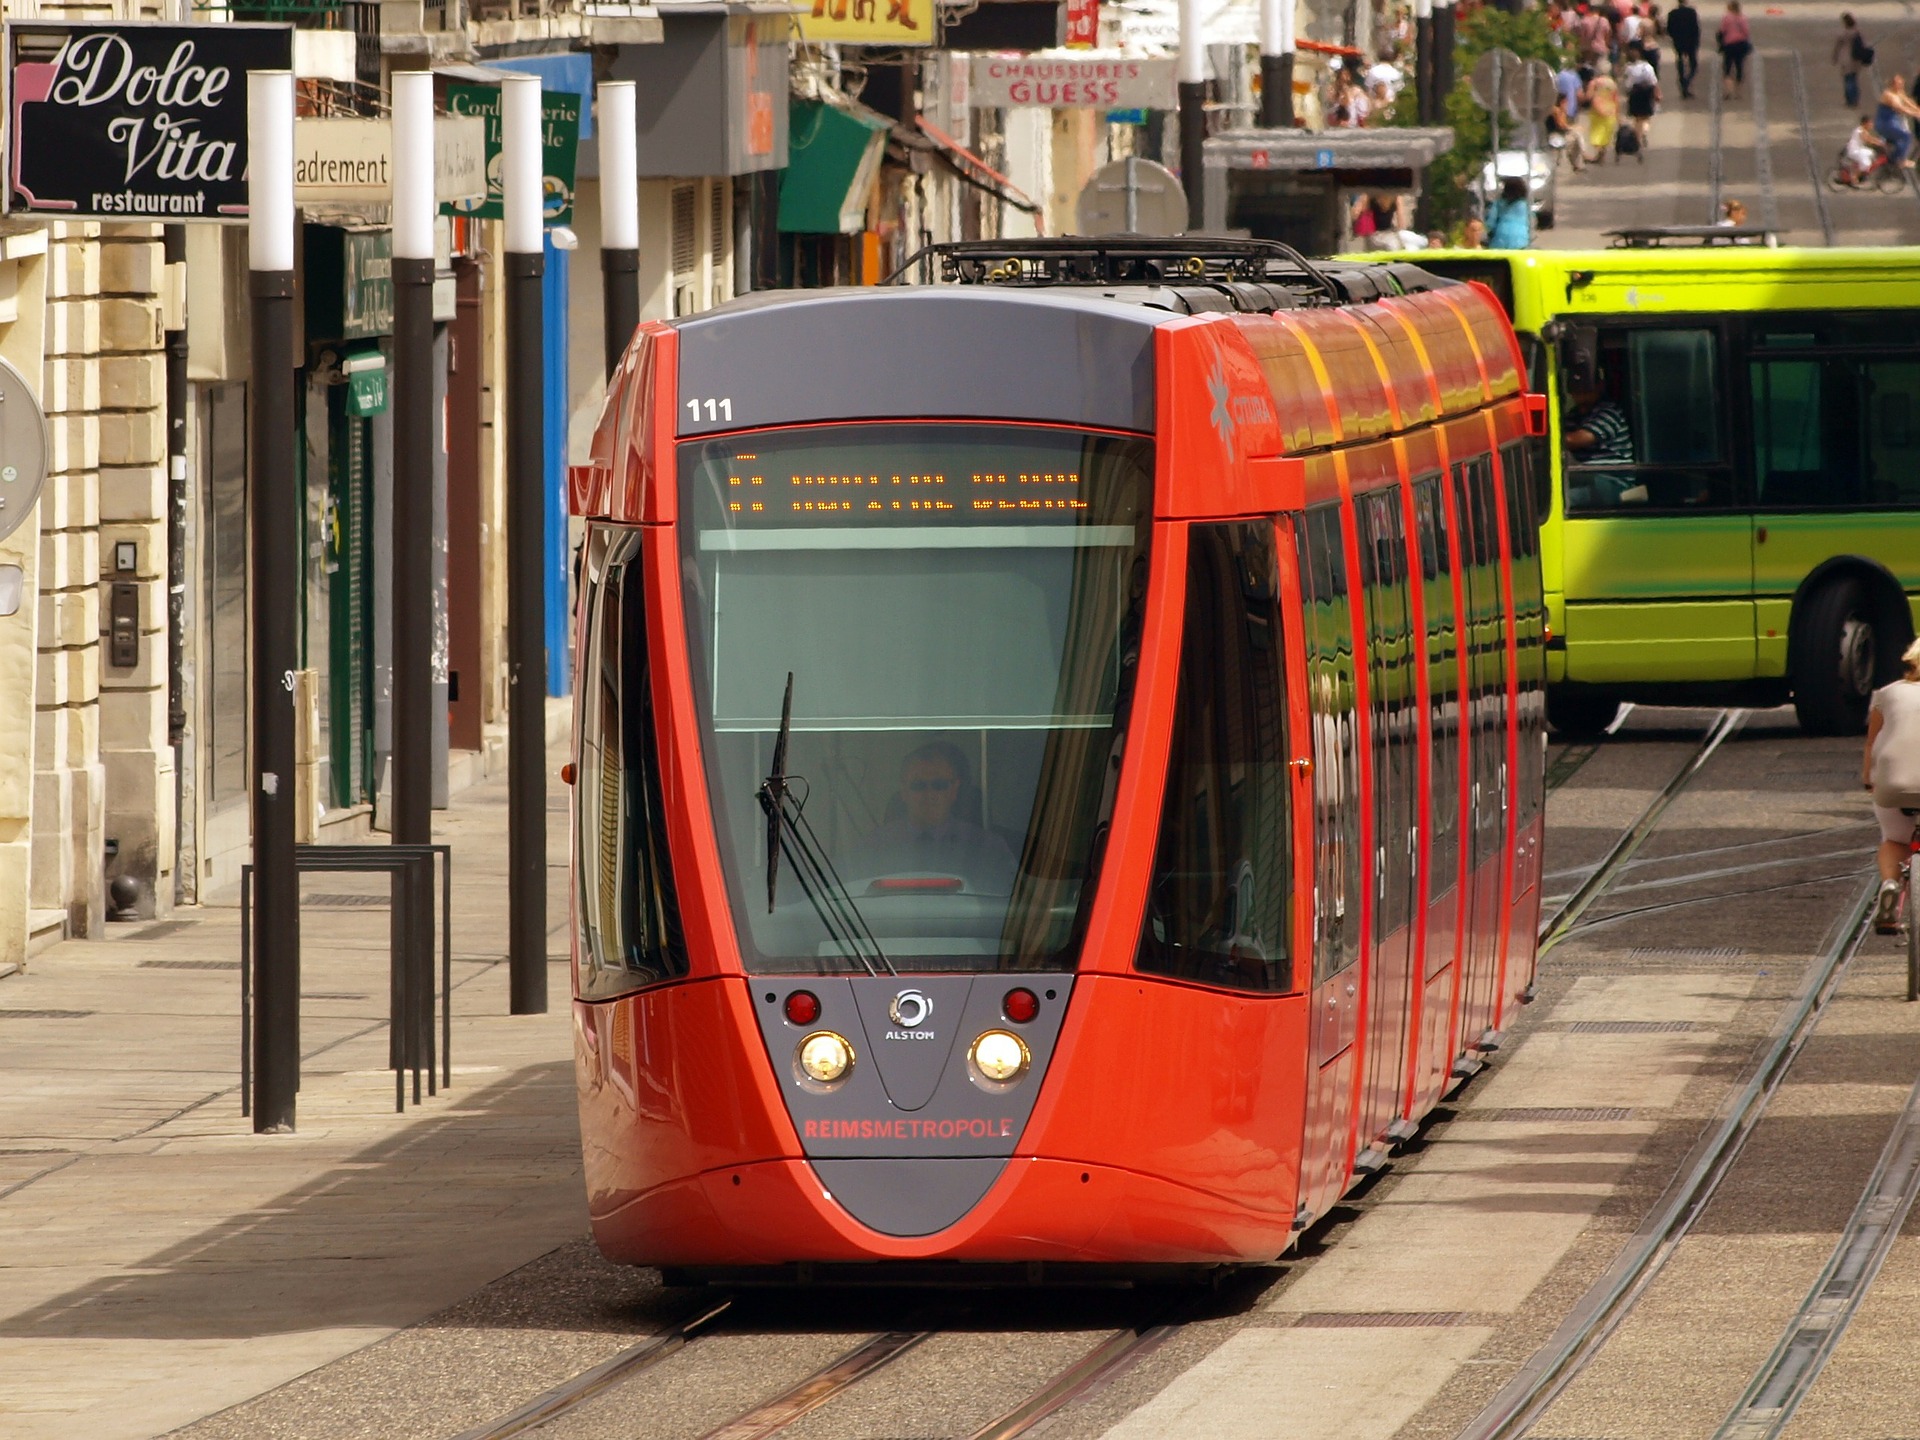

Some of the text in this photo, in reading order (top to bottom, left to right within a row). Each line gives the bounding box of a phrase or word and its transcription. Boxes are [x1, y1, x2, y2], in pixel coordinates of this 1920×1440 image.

[53, 32, 230, 106] Dolce
[988, 63, 1139, 79] CHAUSSURES
[1009, 80, 1118, 104] GUESS
[107, 112, 237, 184] Vita
[296, 150, 387, 183] adrement
[92, 189, 206, 213] restaurant
[686, 398, 732, 421] 111
[885, 1031, 934, 1040] ALSTOM
